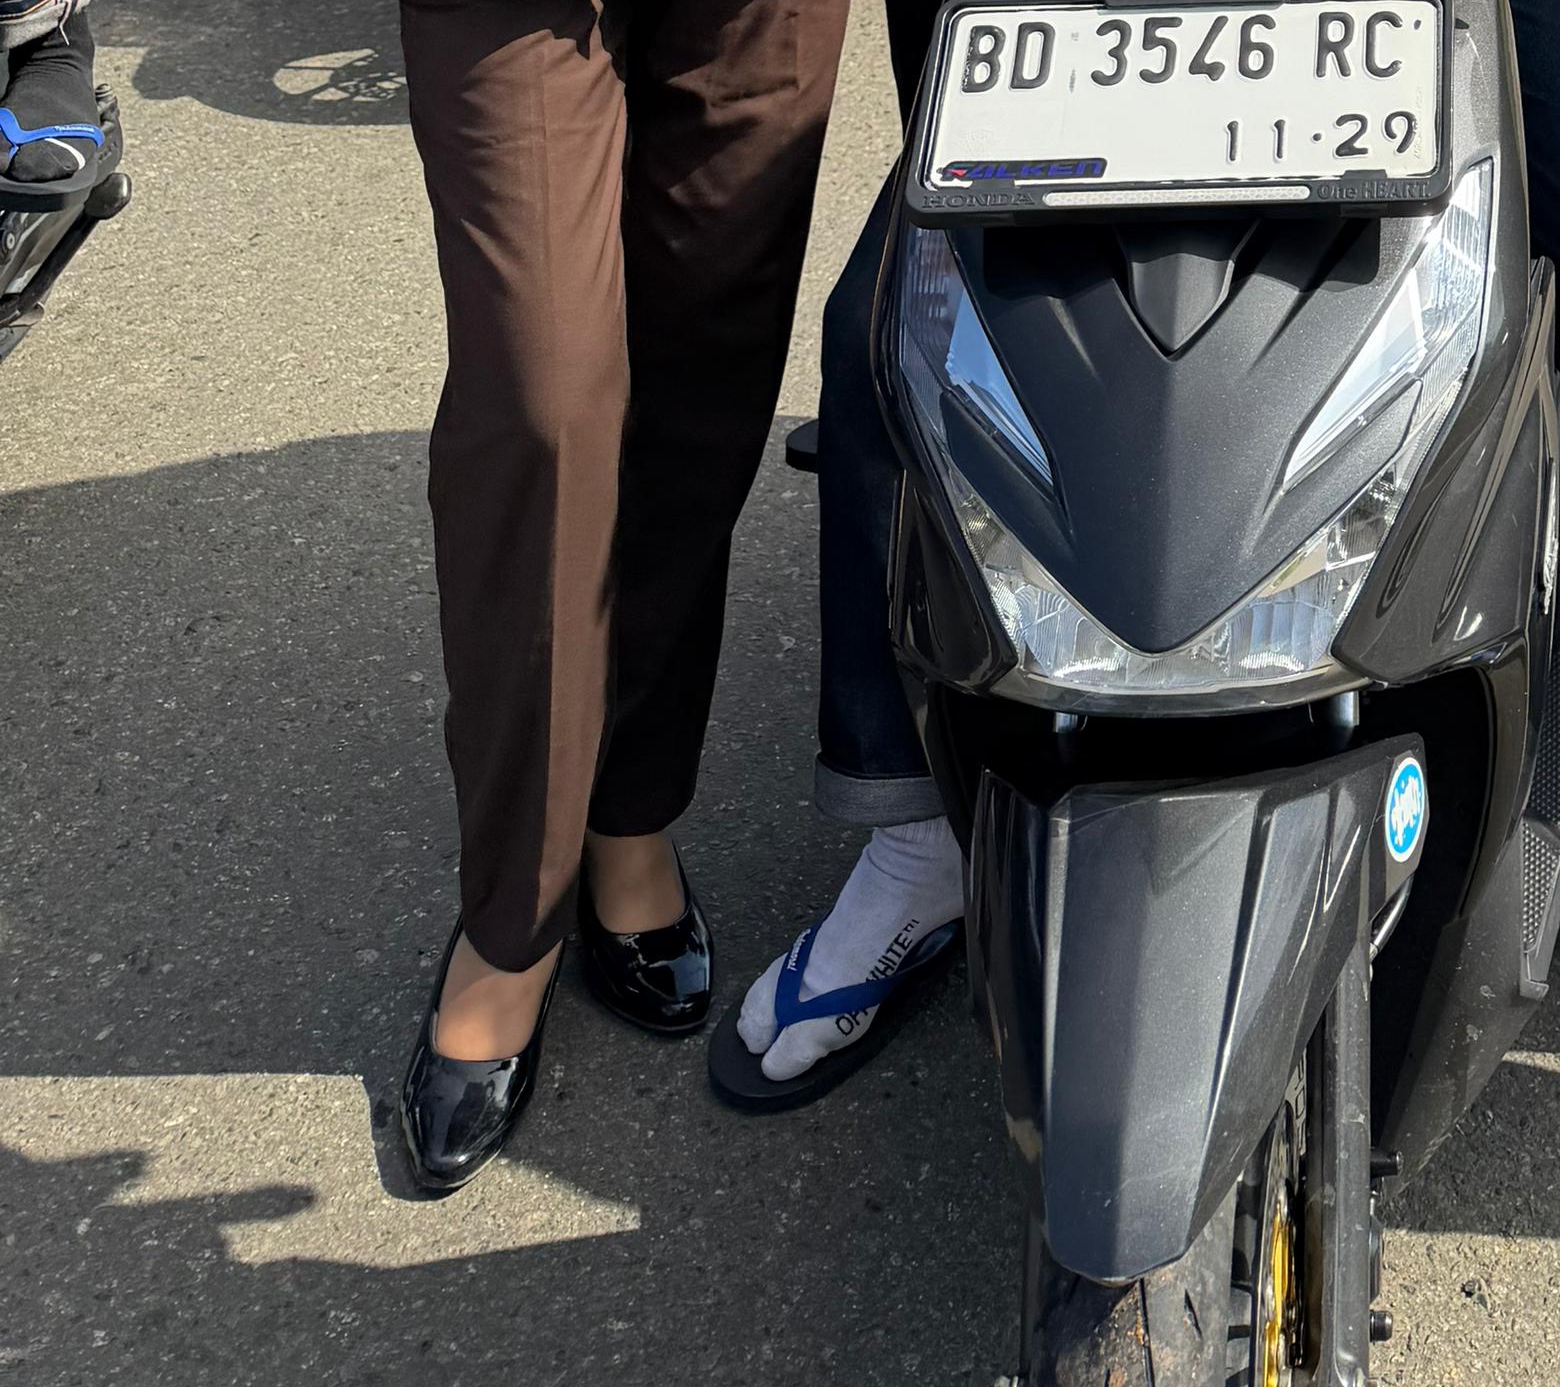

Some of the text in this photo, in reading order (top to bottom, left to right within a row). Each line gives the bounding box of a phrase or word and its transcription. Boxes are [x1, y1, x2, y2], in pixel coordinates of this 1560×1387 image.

[961, 22, 1056, 93] BD
[1090, 13, 1277, 86] 3546
[1315, 10, 1403, 79] RC
[941, 160, 1104, 180] FALKEN
[922, 193, 1036, 209] HONDA
[1317, 184, 1358, 200] One
